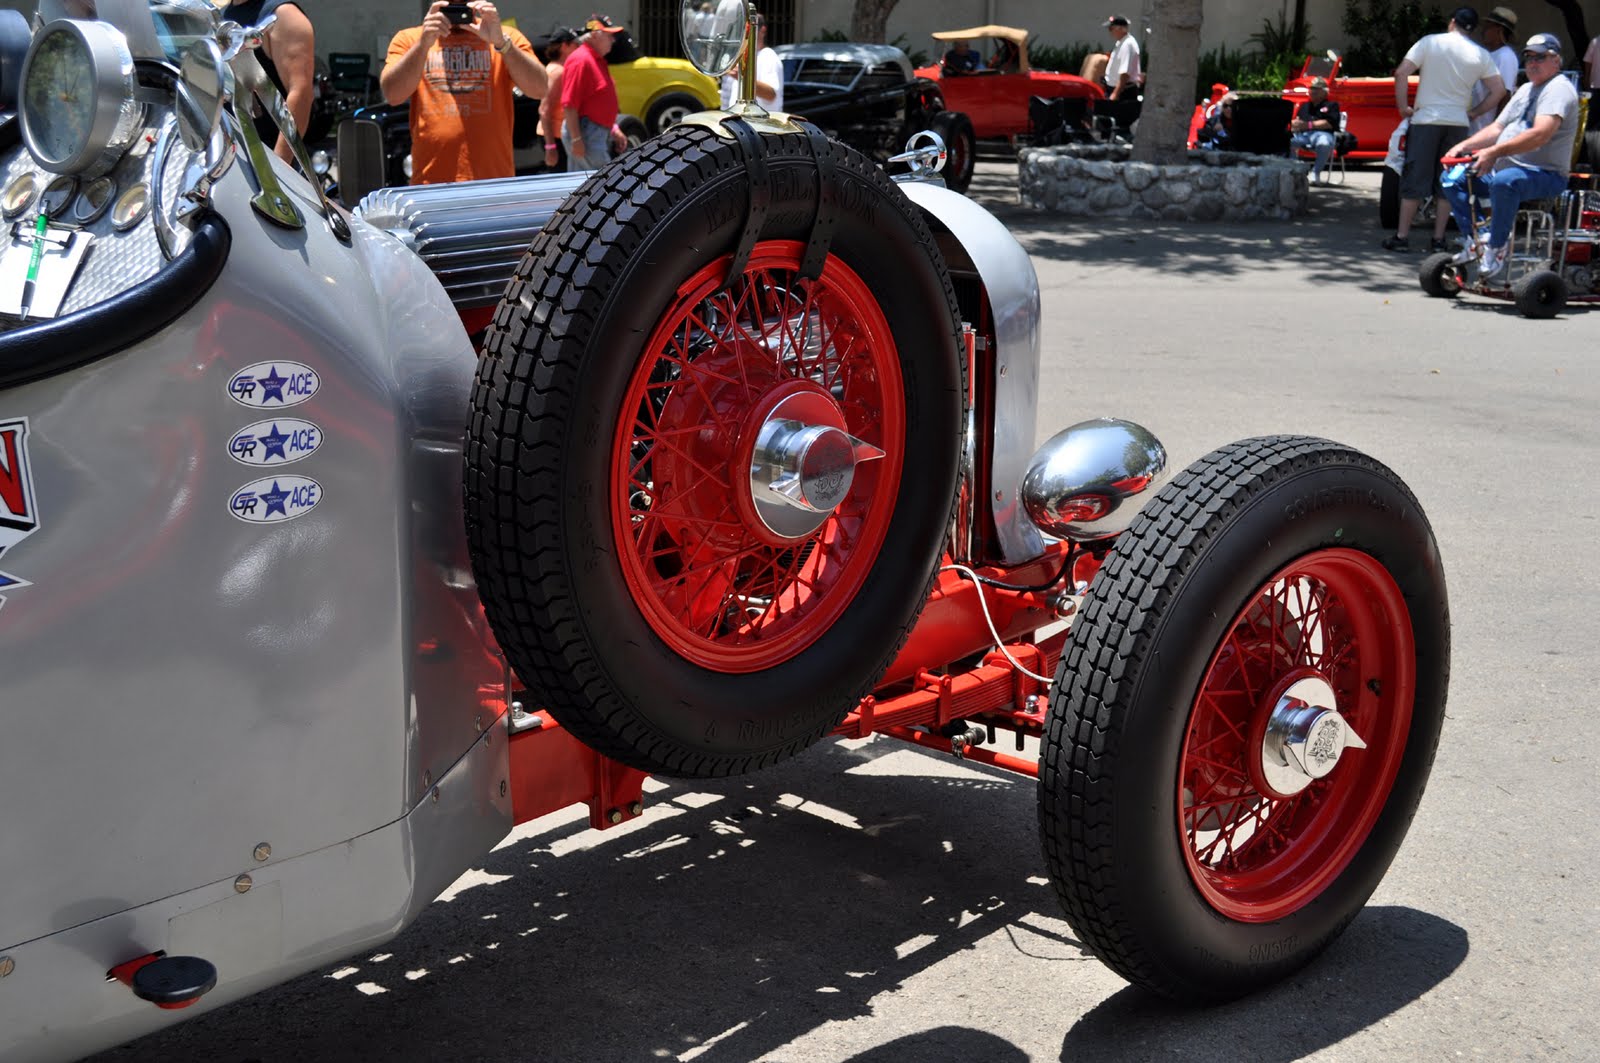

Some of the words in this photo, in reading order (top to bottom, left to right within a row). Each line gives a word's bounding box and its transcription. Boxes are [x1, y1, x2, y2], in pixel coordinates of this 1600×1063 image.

[231, 375, 257, 399] GR
[287, 373, 312, 395] ACE
[231, 434, 257, 458] GR
[290, 428, 315, 452] ACE
[232, 491, 258, 515] GR
[290, 484, 315, 508] ACE
